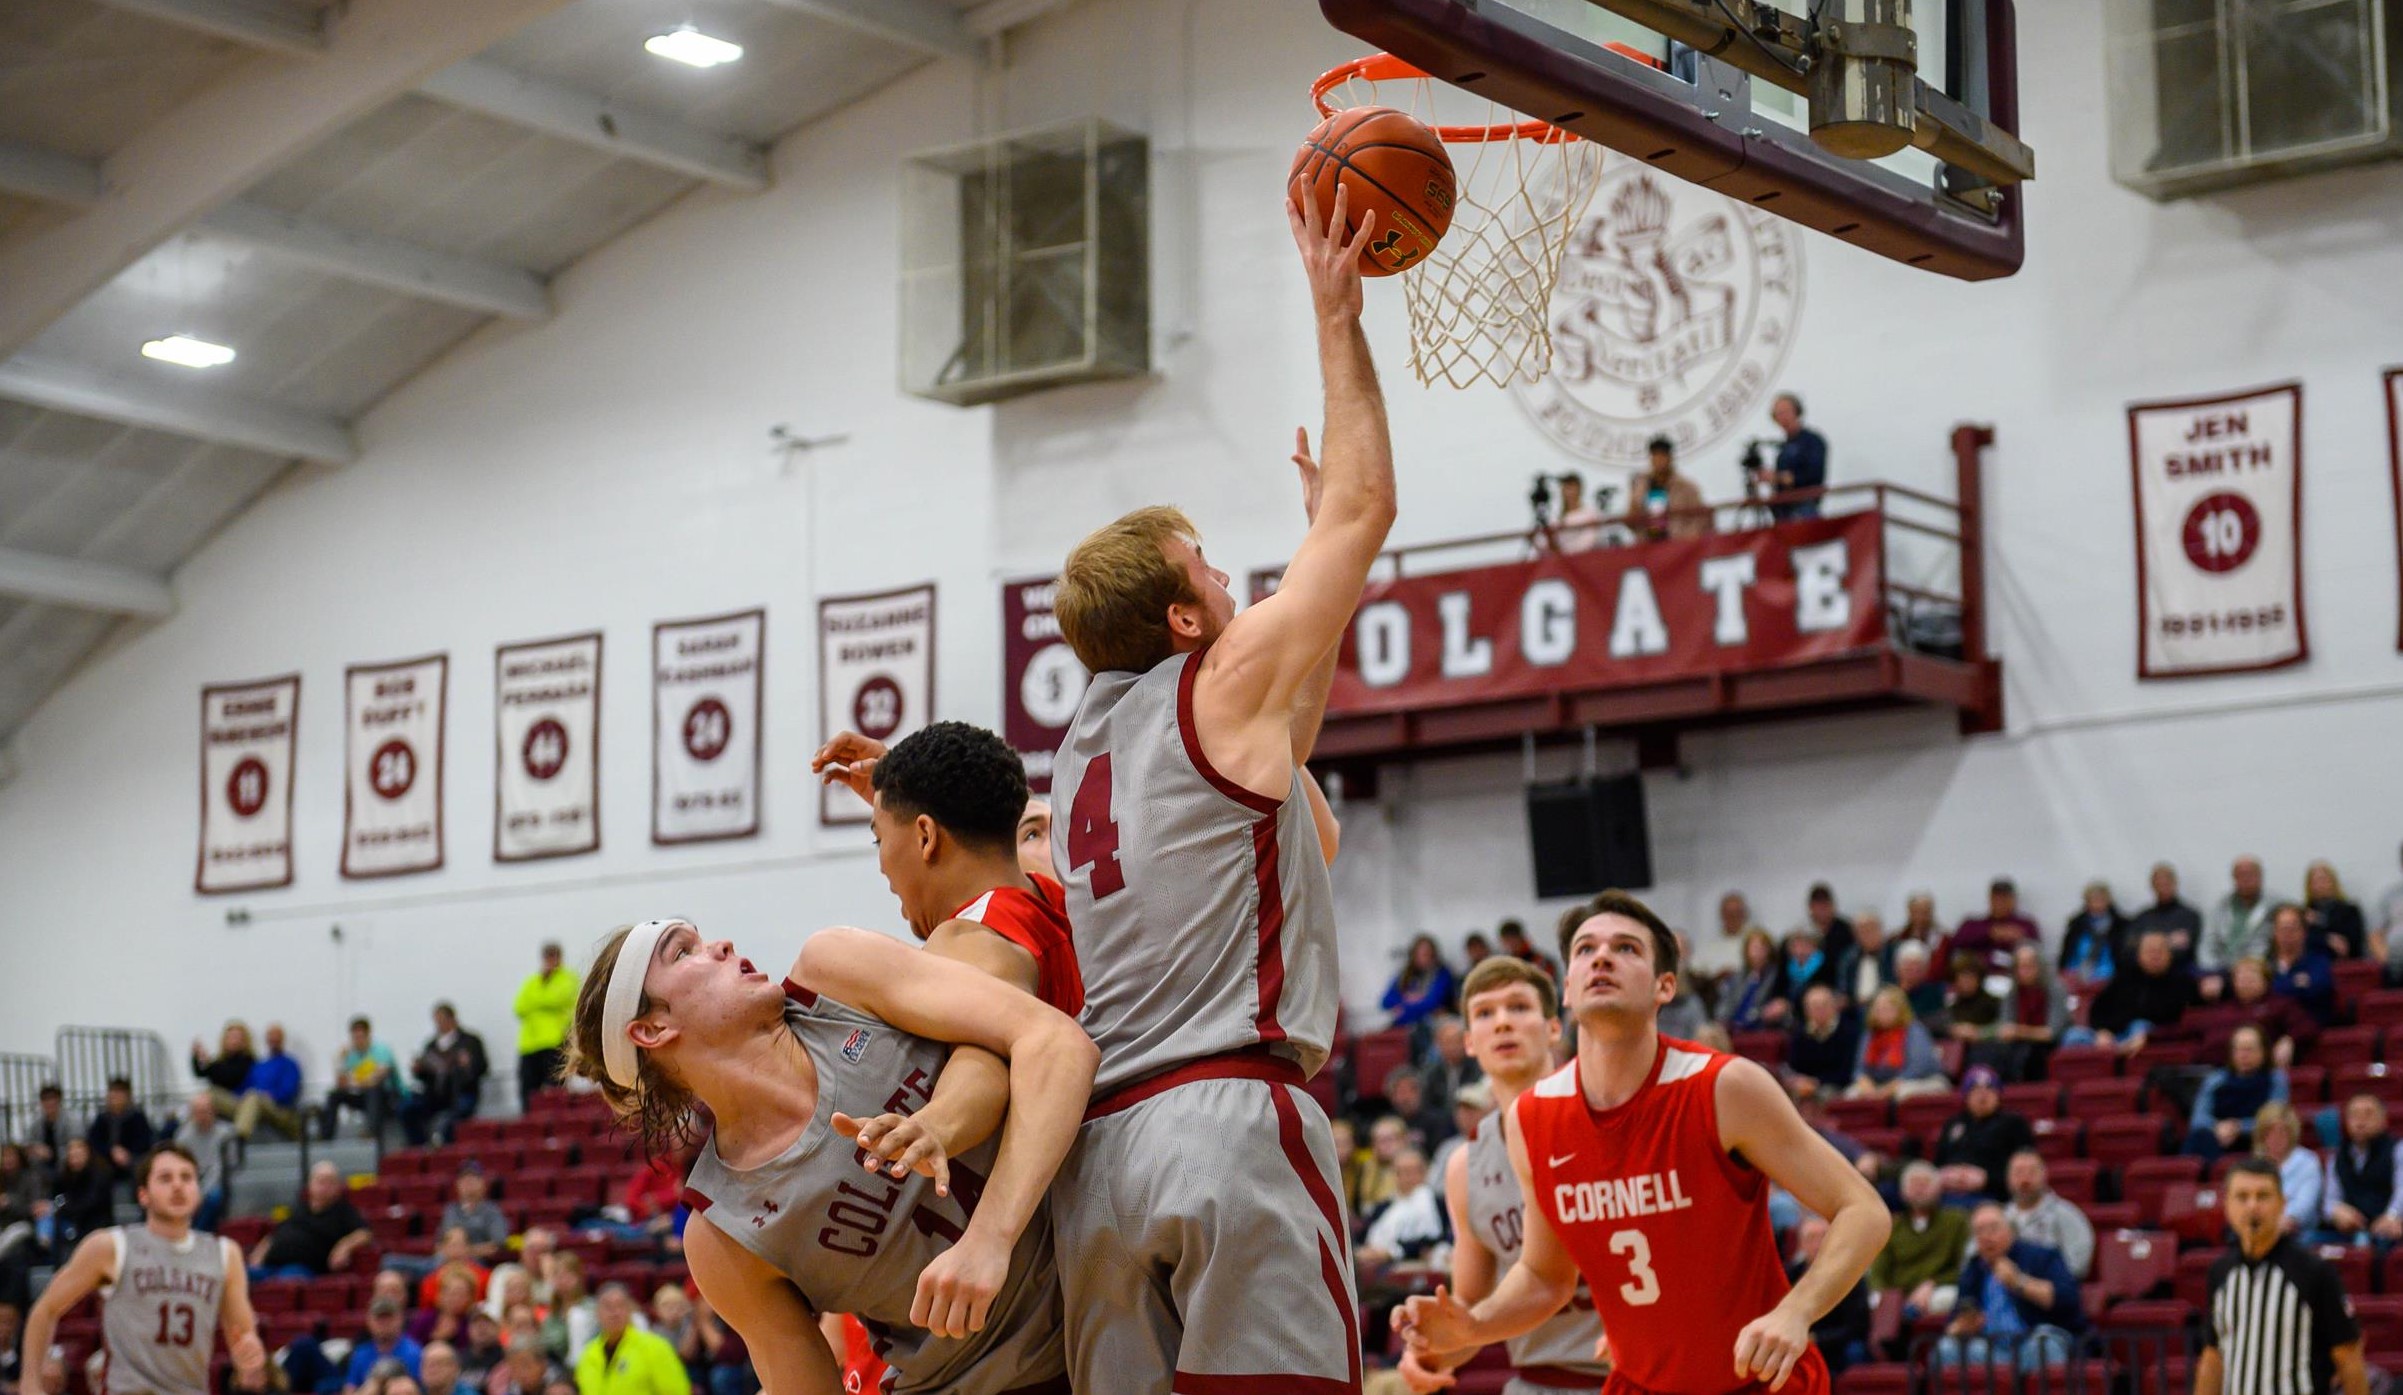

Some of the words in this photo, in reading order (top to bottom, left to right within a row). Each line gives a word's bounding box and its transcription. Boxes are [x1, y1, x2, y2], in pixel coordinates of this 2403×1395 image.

[2186, 413, 2248, 442] JEN
[2165, 444, 2272, 479] SMITH
[2200, 508, 2243, 557] 10
[1357, 539, 1852, 688] OLGATE
[1068, 752, 1126, 900] 4
[1554, 1169, 1692, 1225] CORNELL
[1609, 1228, 1661, 1306] 3
[154, 1300, 195, 1348] 13
